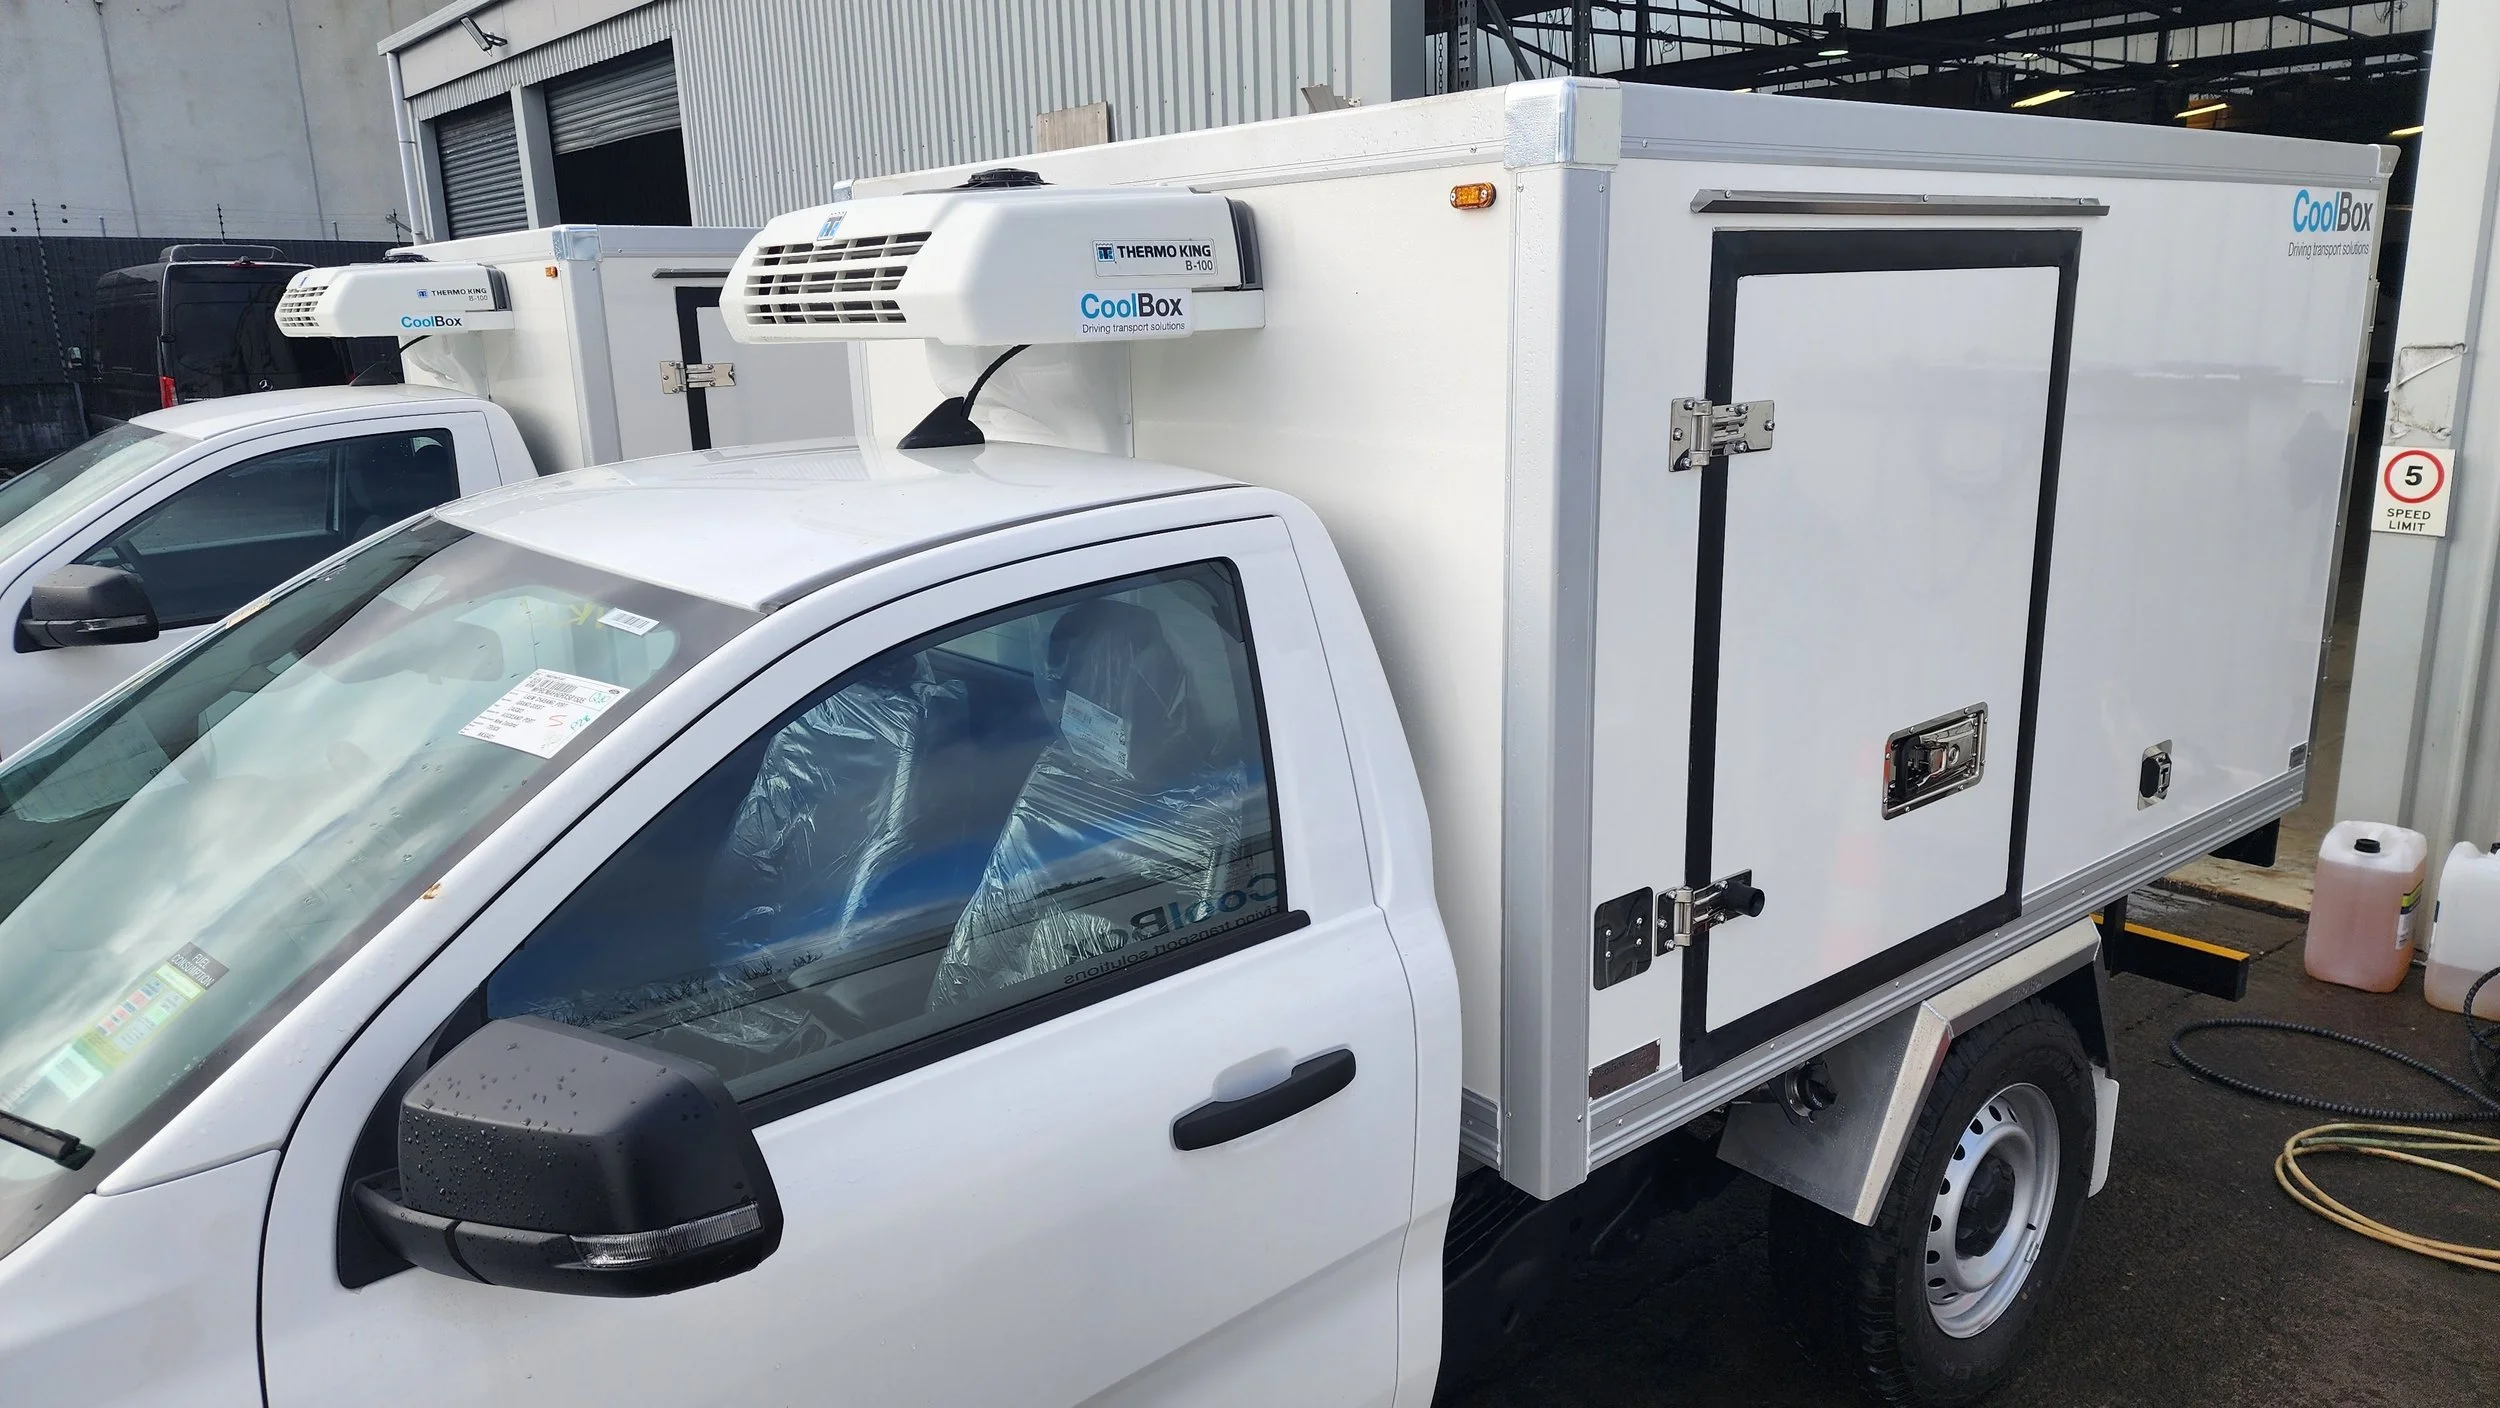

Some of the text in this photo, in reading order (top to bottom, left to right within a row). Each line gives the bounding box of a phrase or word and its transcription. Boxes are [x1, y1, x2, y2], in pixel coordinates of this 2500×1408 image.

[2292, 189, 2374, 232] CoolBox
[1116, 244, 1212, 258] THERMO KING
[2288, 241, 2370, 260] Driving transport solutions
[1185, 260, 1213, 271] B-100
[431, 288, 466, 297] THERMO
[468, 287, 488, 295] KING
[1080, 292, 1184, 319] CoolBox
[401, 315, 463, 328] CoolBox
[1082, 321, 1185, 335] Driving transport solutions
[2404, 465, 2424, 486] 5
[2387, 508, 2431, 520] SPEED
[2388, 520, 2426, 532] LIMIT
[191, 952, 211, 970] FUEL
[171, 954, 215, 987] CONSUMPTION
